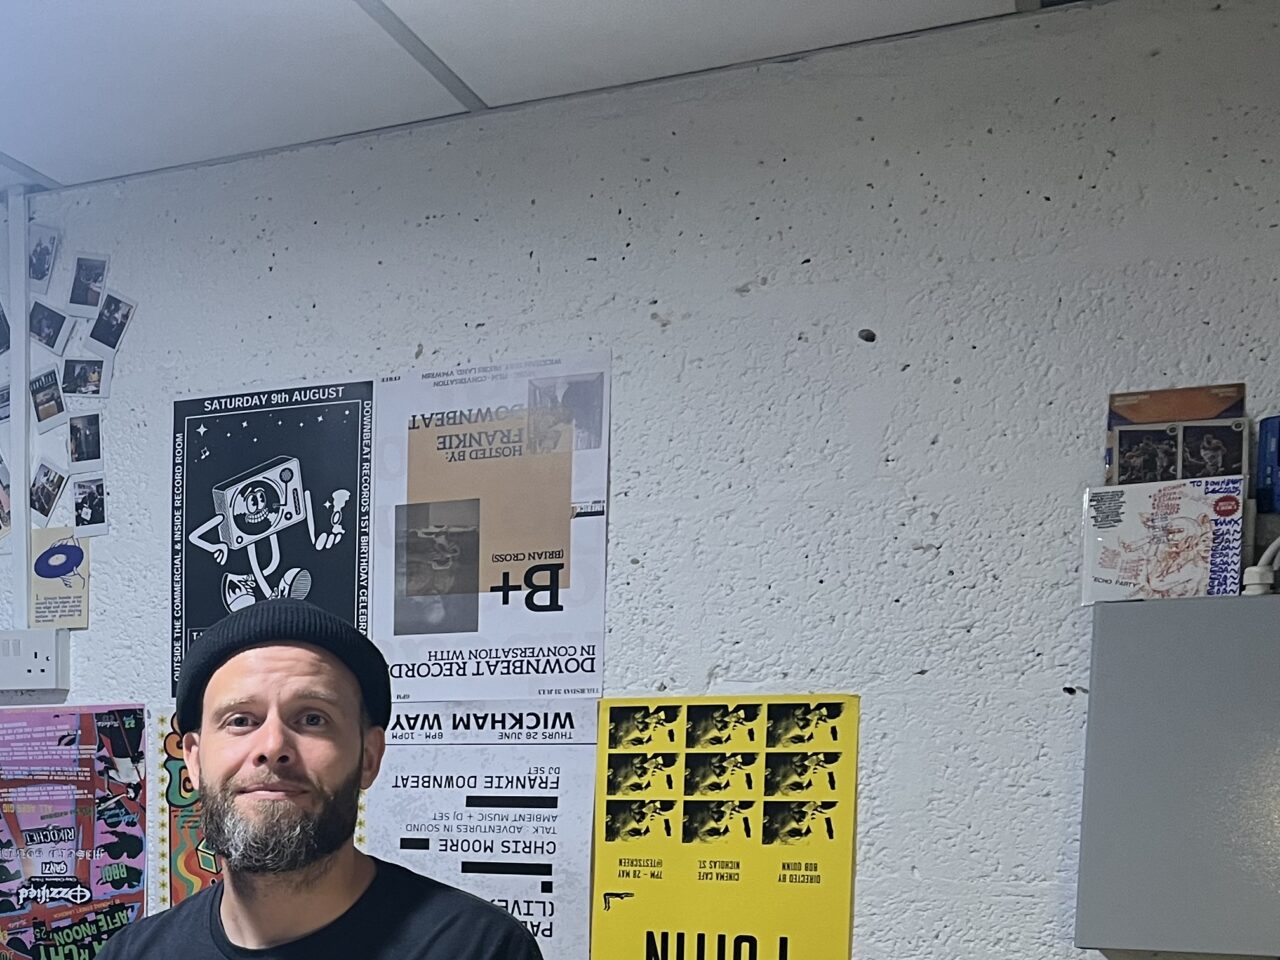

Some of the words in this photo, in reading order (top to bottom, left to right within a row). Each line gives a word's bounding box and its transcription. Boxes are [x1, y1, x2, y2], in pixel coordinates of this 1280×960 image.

[203, 393, 268, 411] SATURDAY
[270, 392, 290, 406] 9th
[292, 386, 345, 402] AUGUST
[408, 404, 524, 430] DOWNBEAT
[362, 401, 373, 459] DOWNBEAT
[436, 428, 523, 450] FRANKIE
[175, 432, 184, 463] ROOM
[469, 445, 523, 459] HOSTED
[445, 448, 466, 461] BY:
[174, 465, 183, 507] RECORD
[361, 463, 371, 512] RECORDS
[174, 509, 183, 541] INSIDE
[361, 515, 370, 532] 1ST
[359, 536, 370, 586] BIRTHDAY
[491, 551, 526, 563] CROSS)
[528, 549, 564, 561] (BRIAN
[173, 552, 182, 617] COMMERCIAL
[490, 563, 564, 612] B+
[173, 619, 182, 638] THE
[428, 649, 463, 662] WITH
[466, 646, 577, 660] CONVERSATION
[580, 645, 596, 656] IN
[386, 662, 467, 678] RECORD
[472, 656, 596, 676] DOWNBEAT
[390, 713, 442, 730] WAY
[452, 712, 575, 730] WICKHAM
[391, 732, 414, 740] 10PM
[498, 732, 523, 740] JUNE
[547, 766, 560, 774] DJ
[391, 775, 477, 789] DOWNBEAT
[484, 776, 560, 789] FRANKIE
[432, 812, 449, 820] SET
[477, 813, 509, 822] MUSIC
[512, 813, 558, 823] AMBIENT
[405, 824, 440, 832] SOUND
[443, 824, 453, 832] IN
[456, 824, 523, 834] ADVENTURES
[532, 825, 556, 834] TALK
[24, 828, 74, 844] RIKOCHET
[438, 838, 494, 853] MOORE
[501, 839, 556, 854] CHRIS
[709, 860, 740, 871] NICHOLAS
[782, 861, 802, 871] QUINN
[805, 862, 818, 872] BOB
[618, 869, 631, 878] MAY
[650, 869, 663, 879] 7PM
[697, 871, 713, 881] CAFE
[714, 872, 740, 882] CINEMA
[778, 874, 786, 883] BY
[789, 873, 821, 884] DIRECTED
[18, 885, 90, 904] Ozzified
